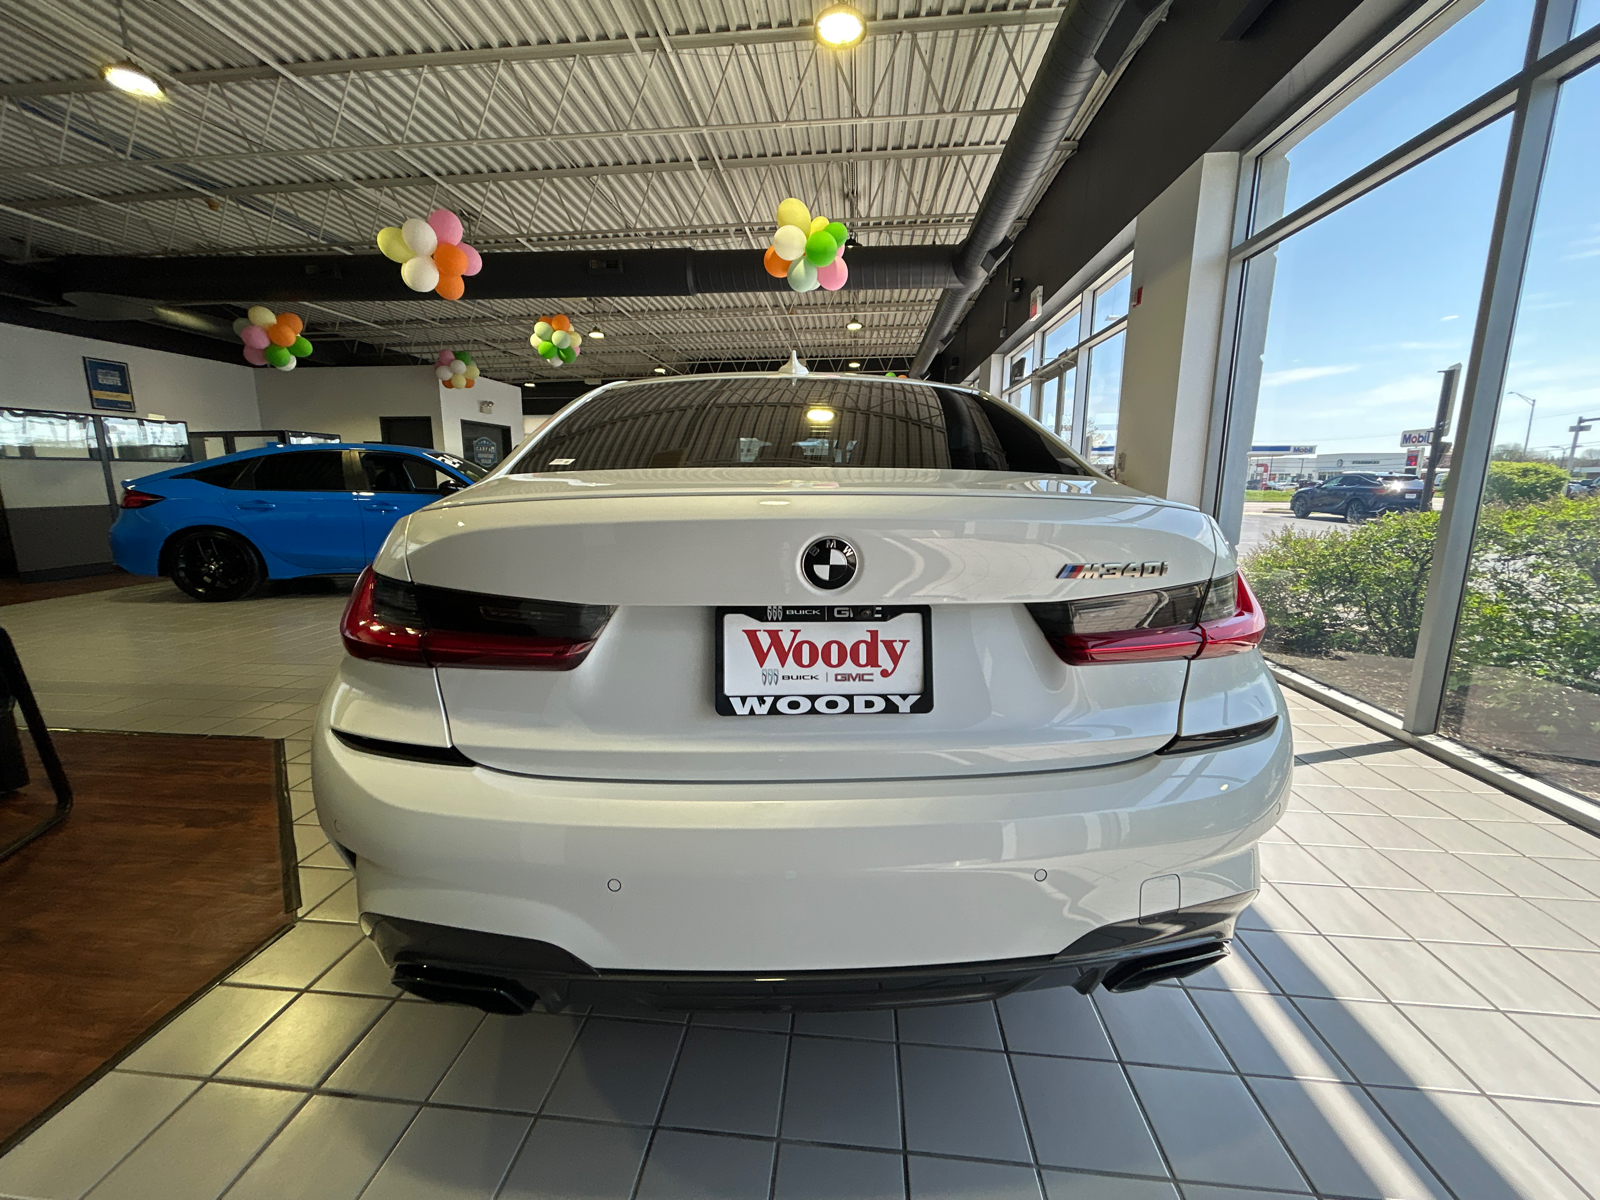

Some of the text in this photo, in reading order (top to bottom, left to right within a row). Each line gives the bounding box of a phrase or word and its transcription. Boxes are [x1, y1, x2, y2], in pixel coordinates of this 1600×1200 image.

[1402, 431, 1430, 444] Mobil
[808, 539, 854, 557] BMW
[742, 629, 910, 678] Woody
[834, 673, 874, 682] GMC
[729, 694, 922, 715] WOODY
